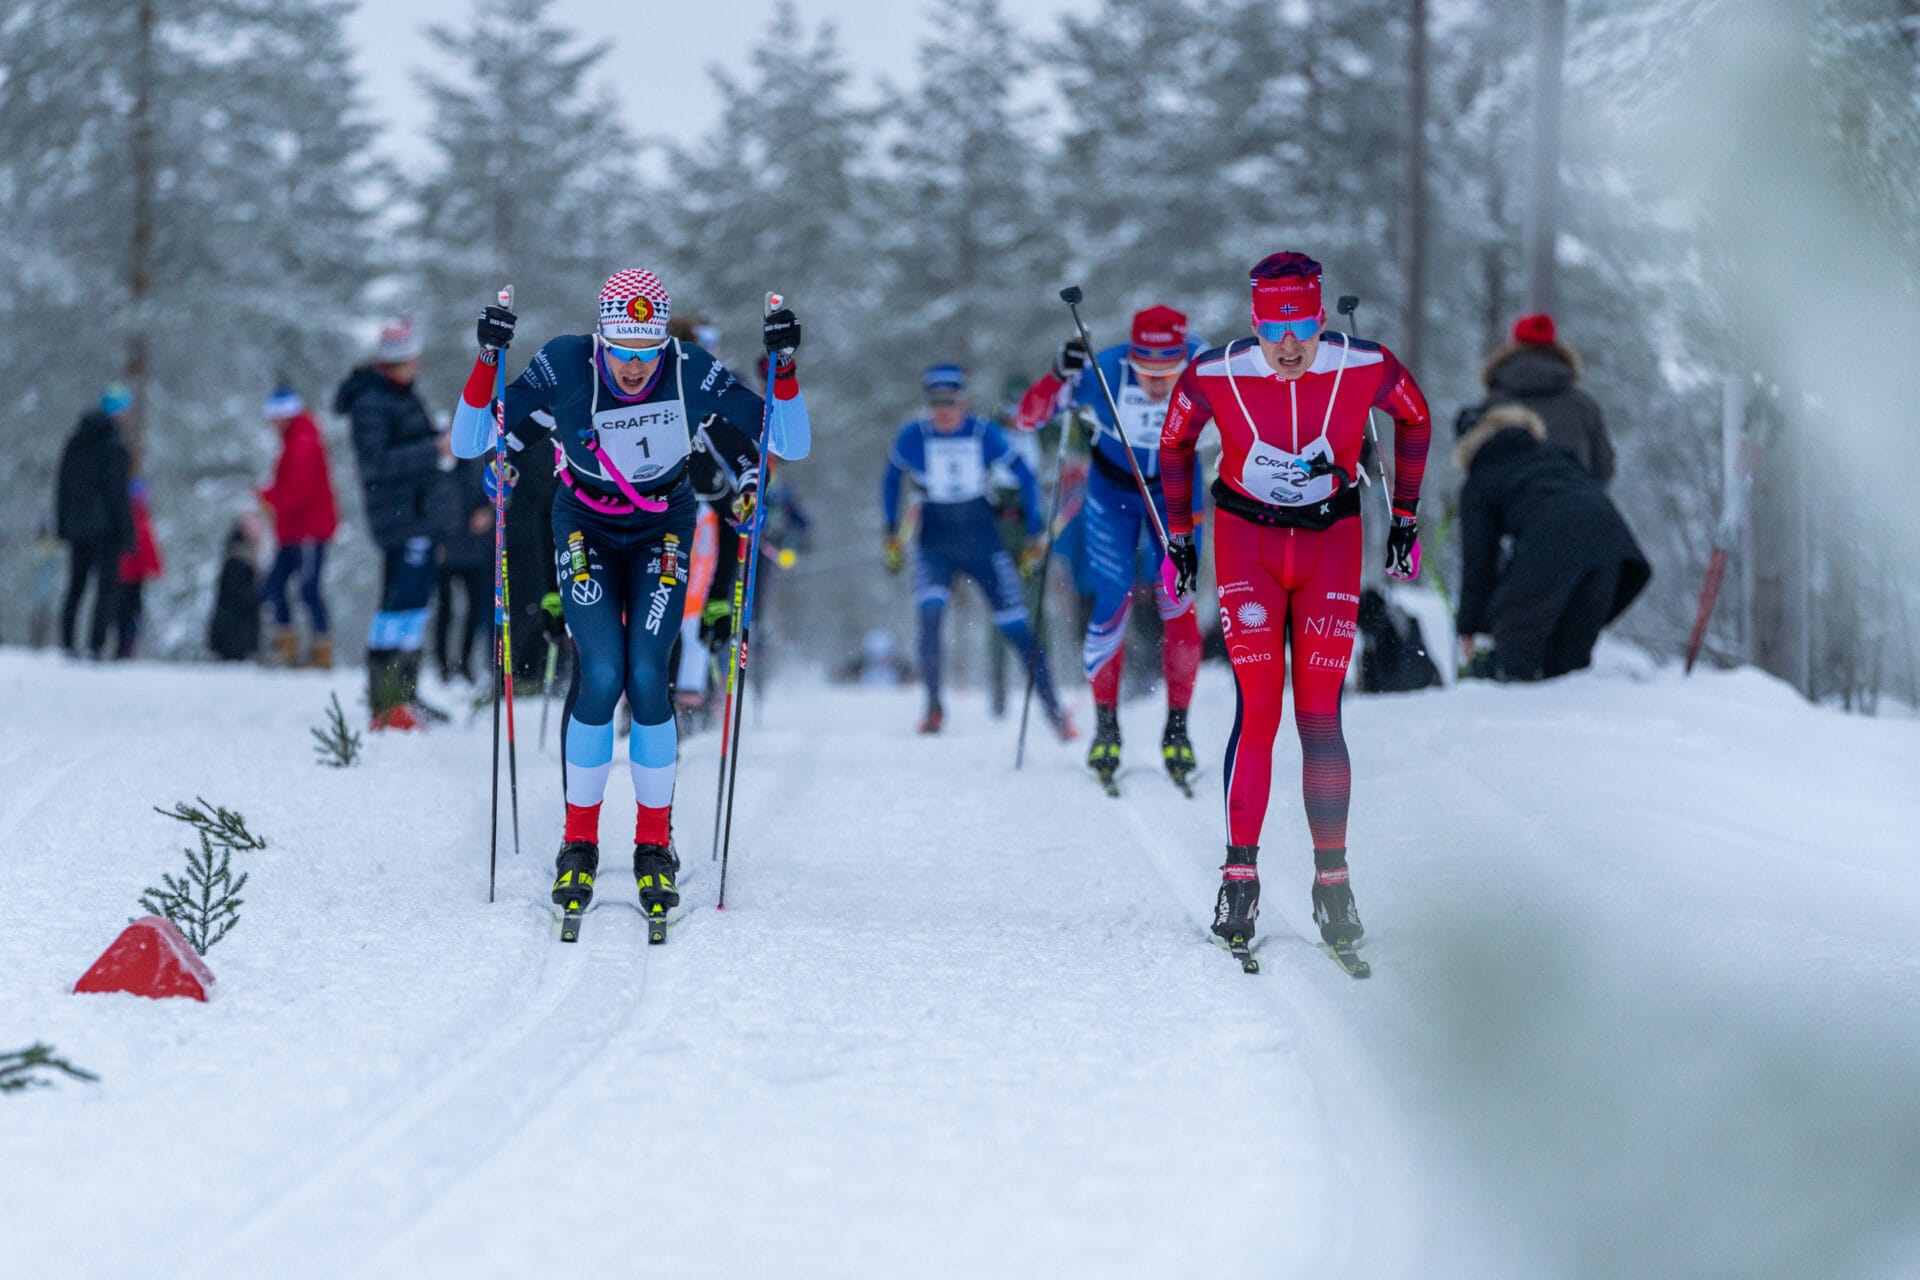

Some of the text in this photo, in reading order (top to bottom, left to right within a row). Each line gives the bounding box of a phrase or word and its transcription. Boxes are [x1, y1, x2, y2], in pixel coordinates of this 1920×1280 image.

[616, 325, 654, 335] ÅSARNA
[602, 413, 662, 430] CRAFT
[635, 436, 650, 459] 1
[1254, 455, 1300, 470] CRAF
[1271, 471, 1310, 488] 22
